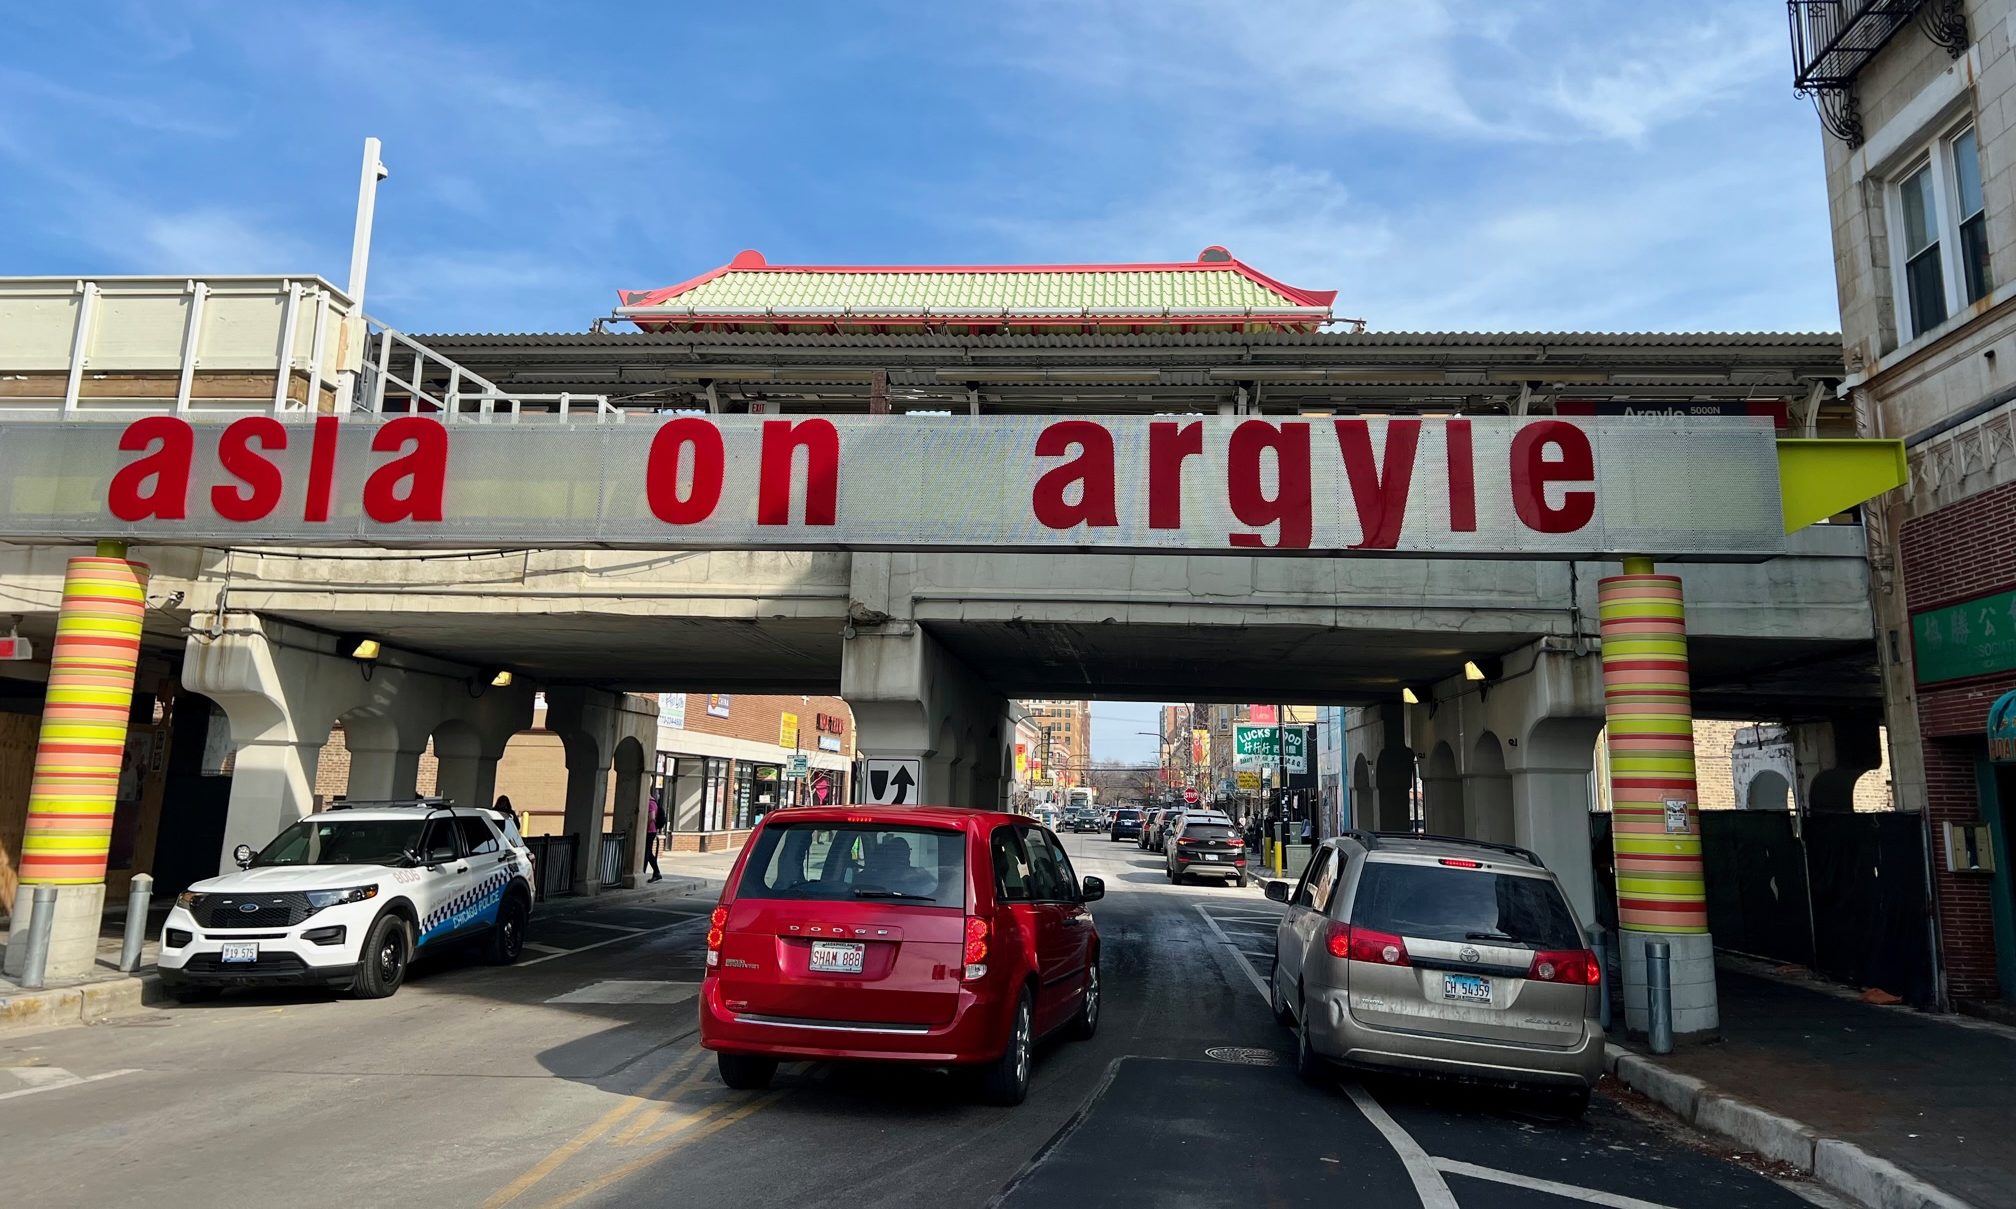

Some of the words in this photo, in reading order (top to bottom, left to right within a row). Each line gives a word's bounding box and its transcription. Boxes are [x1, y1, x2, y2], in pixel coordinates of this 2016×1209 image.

[752, 403, 766, 413] EXIT
[1690, 406, 1720, 415] 5000N
[107, 416, 449, 523] asia
[646, 417, 841, 527] on
[1032, 418, 1596, 549] argyle
[1239, 729, 1270, 744] LUCKS
[452, 903, 478, 929] CHICAGO
[478, 890, 500, 912] POLICE
[789, 925, 888, 935] DODGE
[230, 948, 239, 959] 19
[241, 948, 254, 958] 575
[812, 950, 838, 966] SHAM
[842, 952, 861, 967] 888
[1445, 980, 1457, 994] CH
[1462, 982, 1490, 998] 54359
